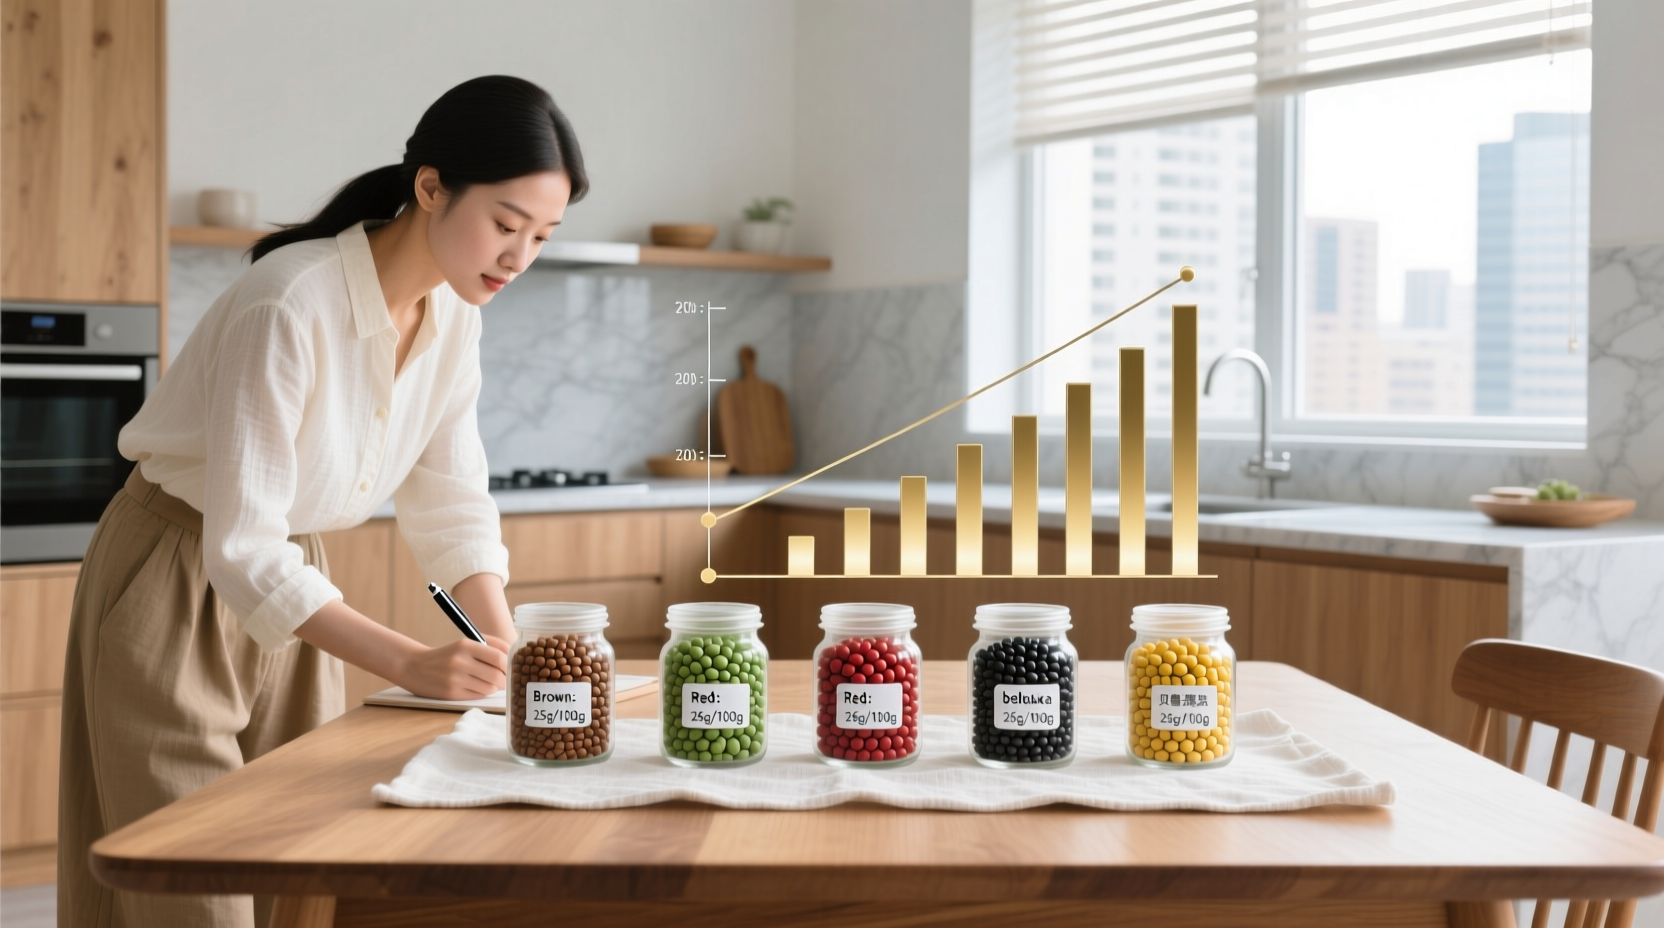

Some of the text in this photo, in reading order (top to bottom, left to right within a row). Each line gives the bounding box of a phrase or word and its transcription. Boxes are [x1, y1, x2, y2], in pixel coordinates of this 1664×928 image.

[533, 690, 576, 703] Brown:
[691, 691, 720, 704] Red:
[844, 691, 872, 704] Red:
